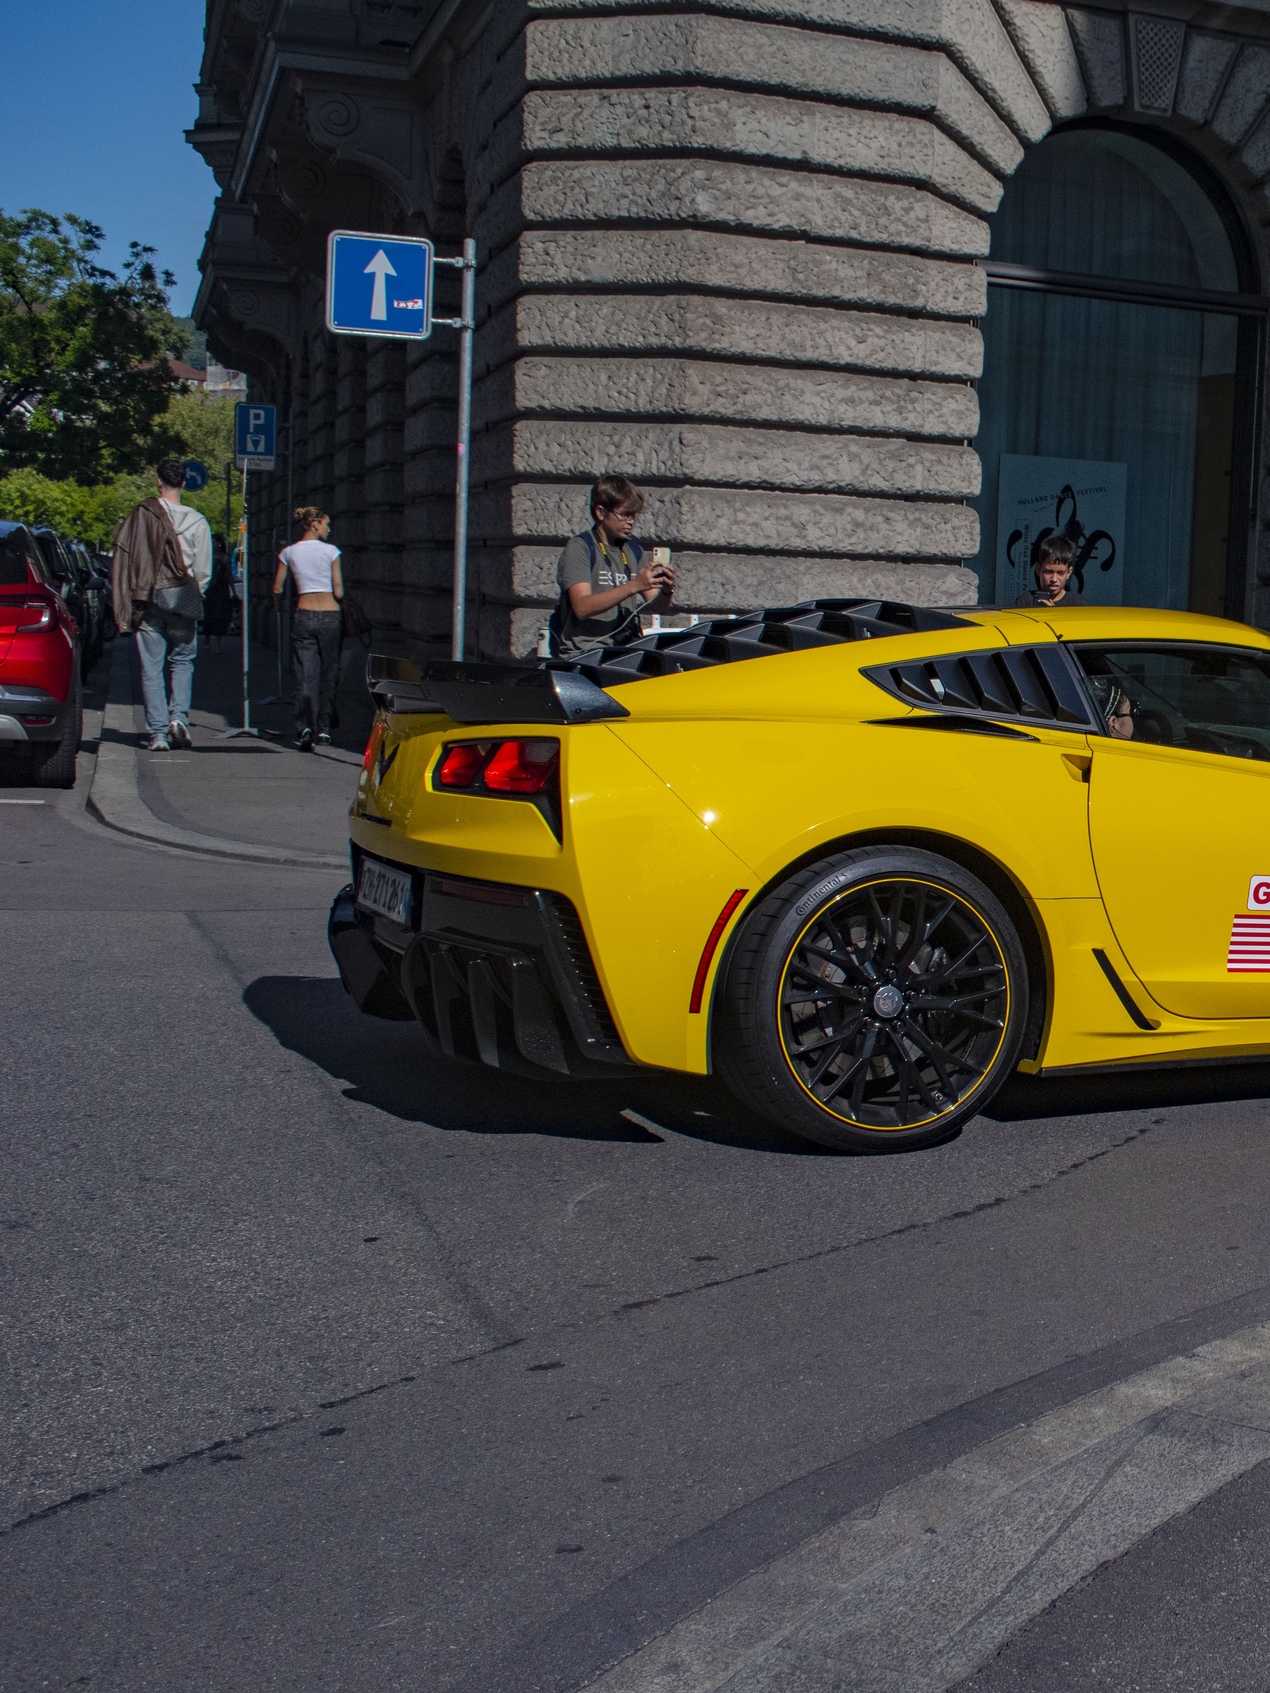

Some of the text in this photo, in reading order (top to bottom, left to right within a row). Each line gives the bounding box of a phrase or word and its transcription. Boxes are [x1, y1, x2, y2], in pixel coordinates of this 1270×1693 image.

[249, 409, 265, 432] P
[1017, 486, 1107, 505] HOLLAND DANCE FESTIVAL
[796, 875, 842, 916] Continental
